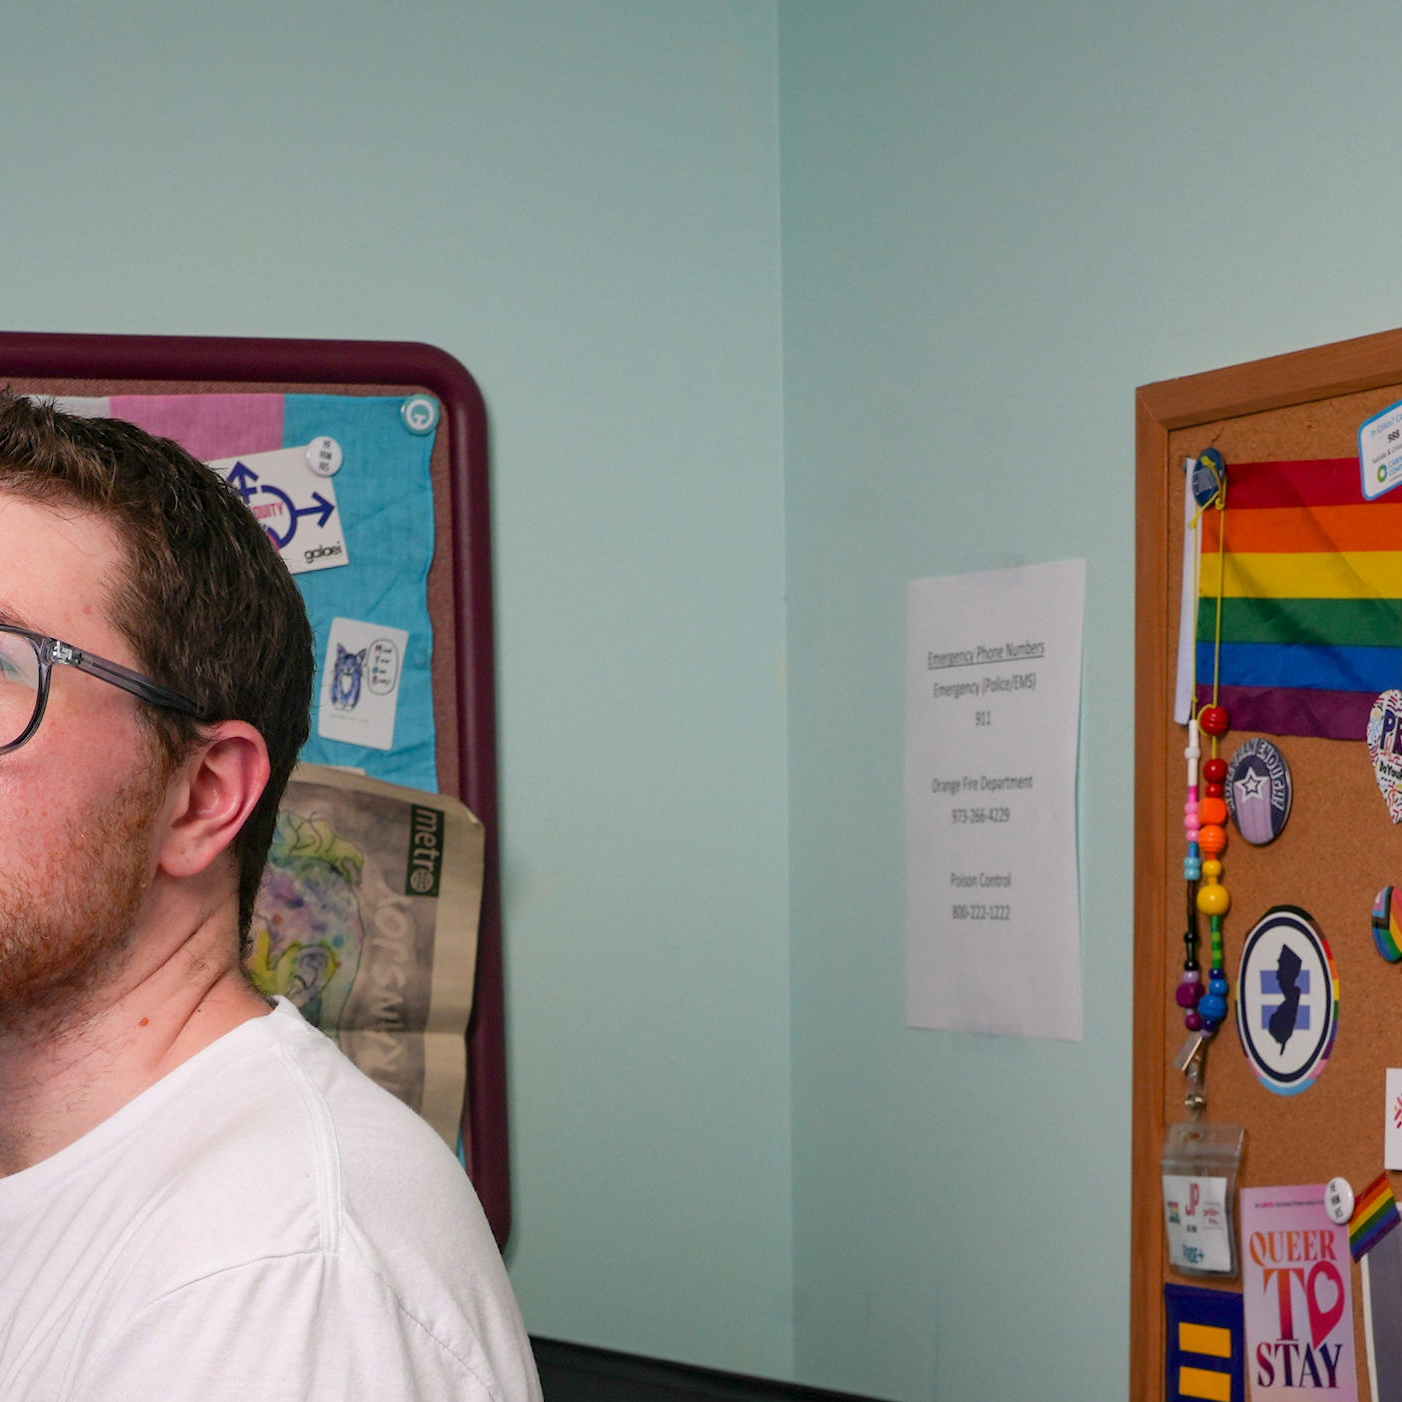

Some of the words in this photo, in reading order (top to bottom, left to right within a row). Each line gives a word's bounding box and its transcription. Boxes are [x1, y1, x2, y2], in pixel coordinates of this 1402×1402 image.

[928, 651, 974, 668] Emergency
[977, 646, 1004, 660] Phone
[1006, 641, 1045, 656] Numbers
[933, 682, 979, 699] Emergency
[975, 710, 990, 726] 911
[932, 778, 960, 795] Orange
[963, 777, 978, 791] Fire
[980, 775, 1033, 792] Department
[951, 872, 977, 887] Poison
[979, 872, 1012, 888] Control
[1250, 1229, 1337, 1268] QUEER
[1263, 1260, 1345, 1351] TO
[1256, 1342, 1343, 1389] STAY
